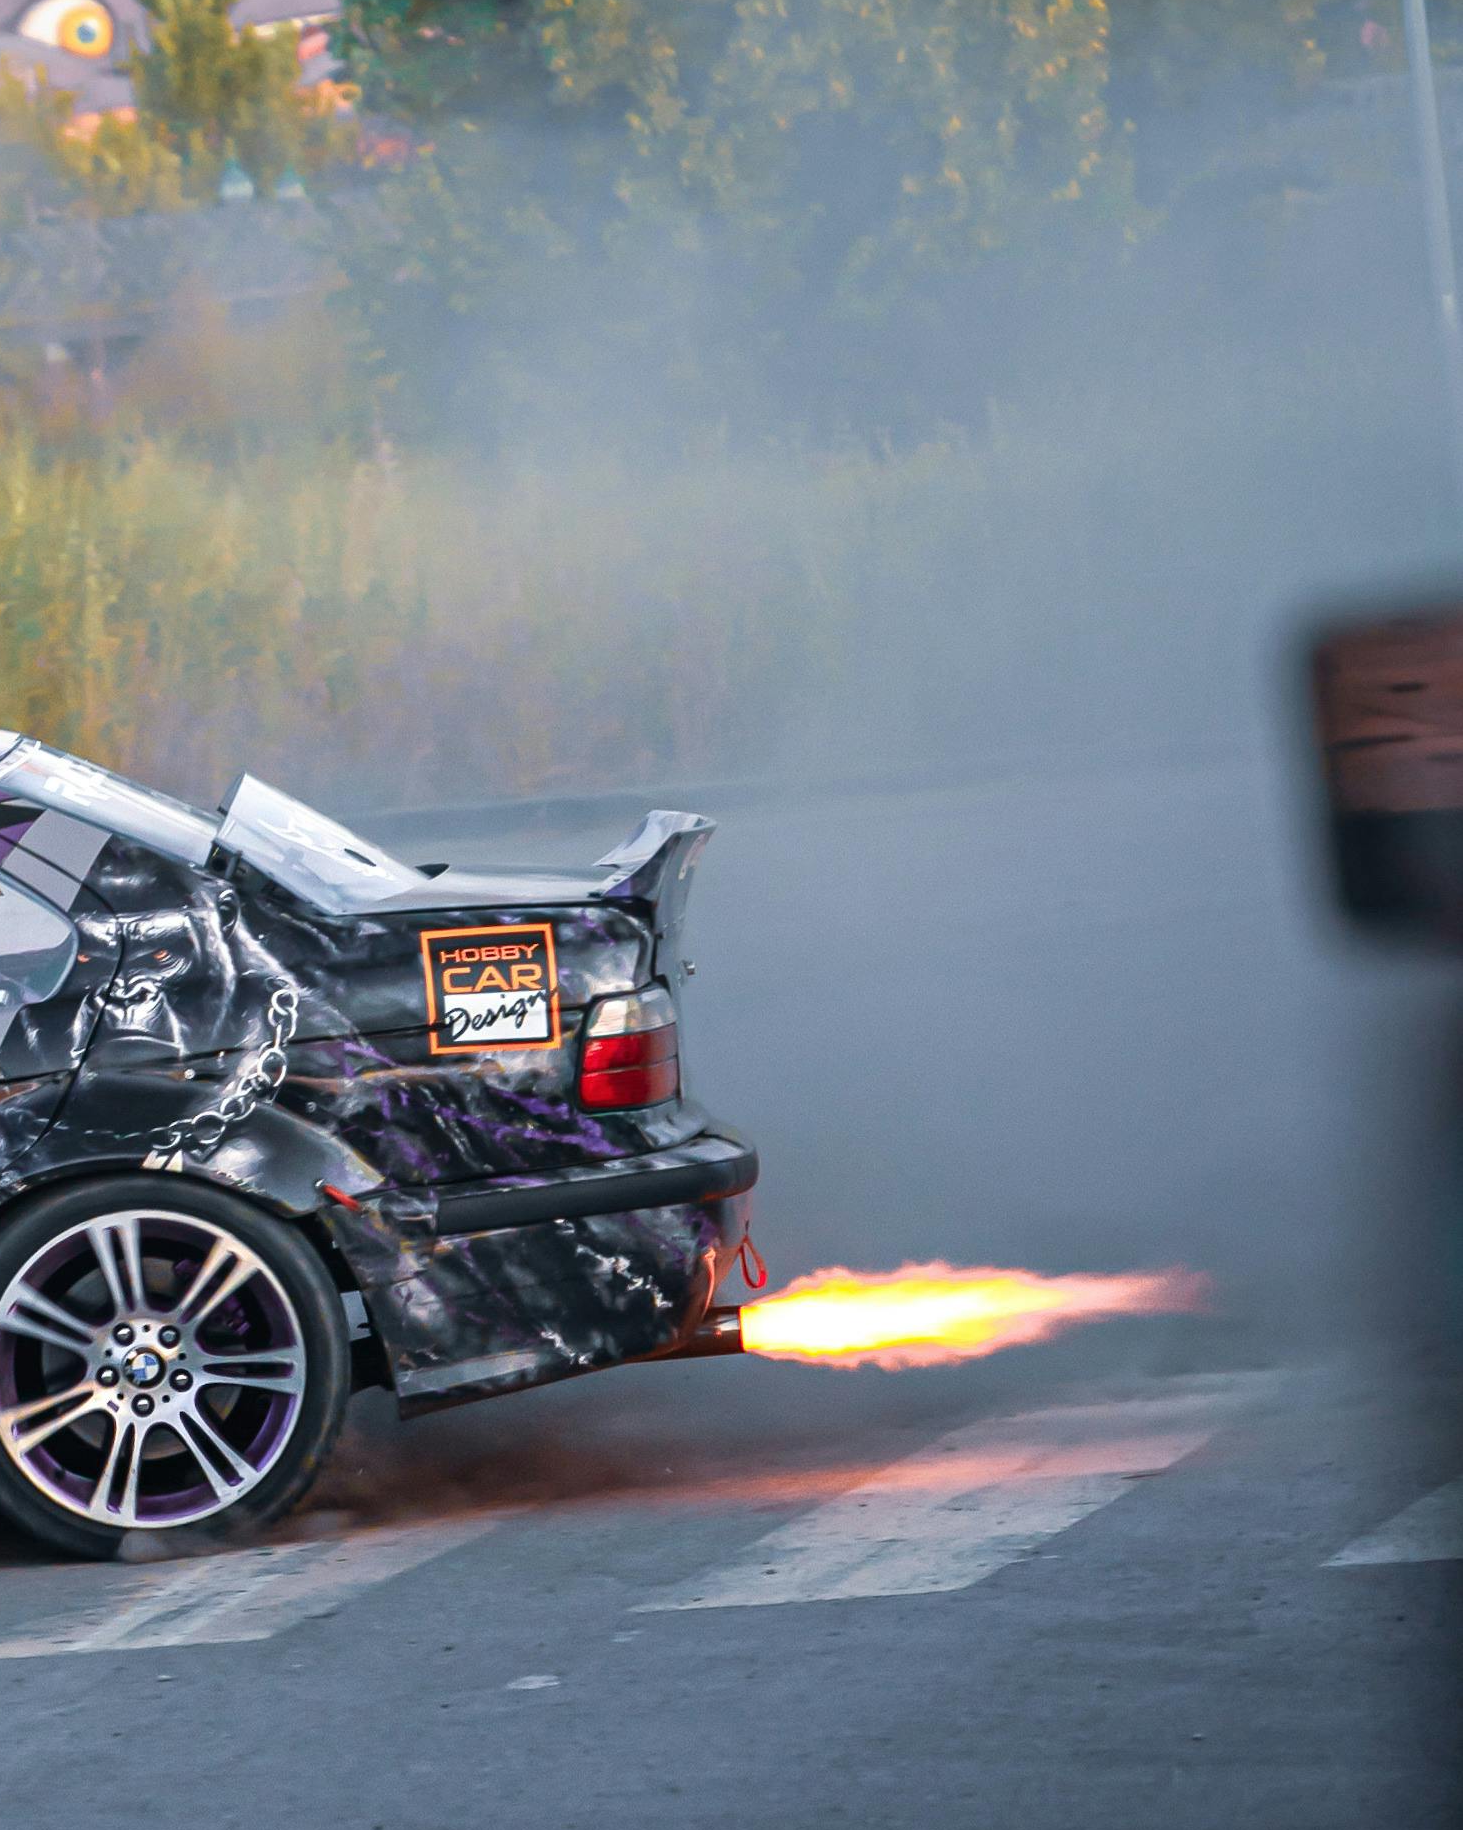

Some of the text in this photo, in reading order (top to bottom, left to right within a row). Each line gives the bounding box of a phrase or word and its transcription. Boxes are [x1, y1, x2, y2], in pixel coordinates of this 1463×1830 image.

[440, 943, 540, 964] HOBBY
[442, 963, 543, 994] CAR
[442, 990, 551, 1041] Design
